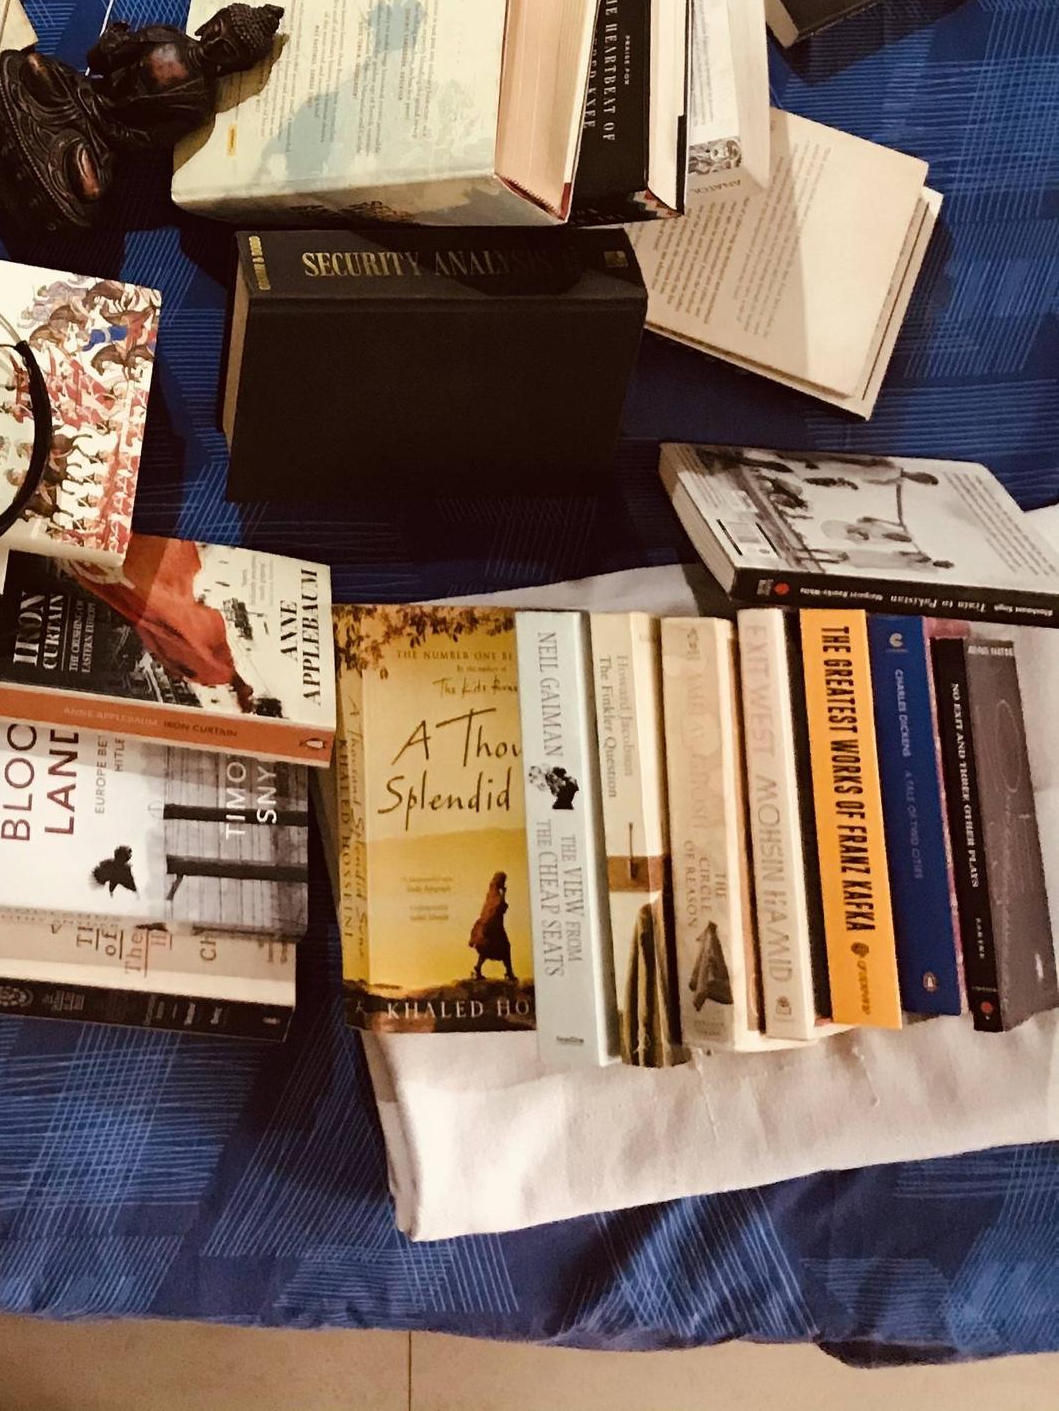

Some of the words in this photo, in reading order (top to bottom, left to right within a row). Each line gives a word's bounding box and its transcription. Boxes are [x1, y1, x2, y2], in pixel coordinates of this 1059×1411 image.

[603, 23, 618, 114] HEARTBEAT
[302, 251, 421, 278] SECURITY
[13, 591, 46, 667] IRON
[42, 594, 65, 670] CURTAIN
[280, 600, 298, 661] ANNE
[301, 568, 322, 706] APPLEBAUM
[537, 632, 558, 673] NEIL
[821, 626, 852, 653] THE
[540, 678, 564, 758] GAIMAN
[823, 658, 858, 733] GREATEST
[895, 669, 907, 712] CHARLES
[163, 720, 190, 732] IRON
[392, 720, 431, 766] A
[899, 715, 912, 758] DICKENS
[1, 723, 38, 842] BLOO
[602, 736, 618, 799] Question
[830, 739, 863, 795] WORKS
[377, 766, 511, 831] Splendid
[834, 800, 866, 820] OF
[561, 835, 577, 862] THE
[756, 774, 785, 883] MOHSIN
[837, 825, 872, 875] FRANZ
[539, 851, 559, 915] CHEAP
[562, 867, 584, 918] VIEW
[843, 880, 876, 932] KAFKA
[542, 917, 565, 977] SEATS
[566, 920, 584, 963] FROM
[764, 890, 794, 983] HAMID
[387, 1001, 485, 1021] KHALED
